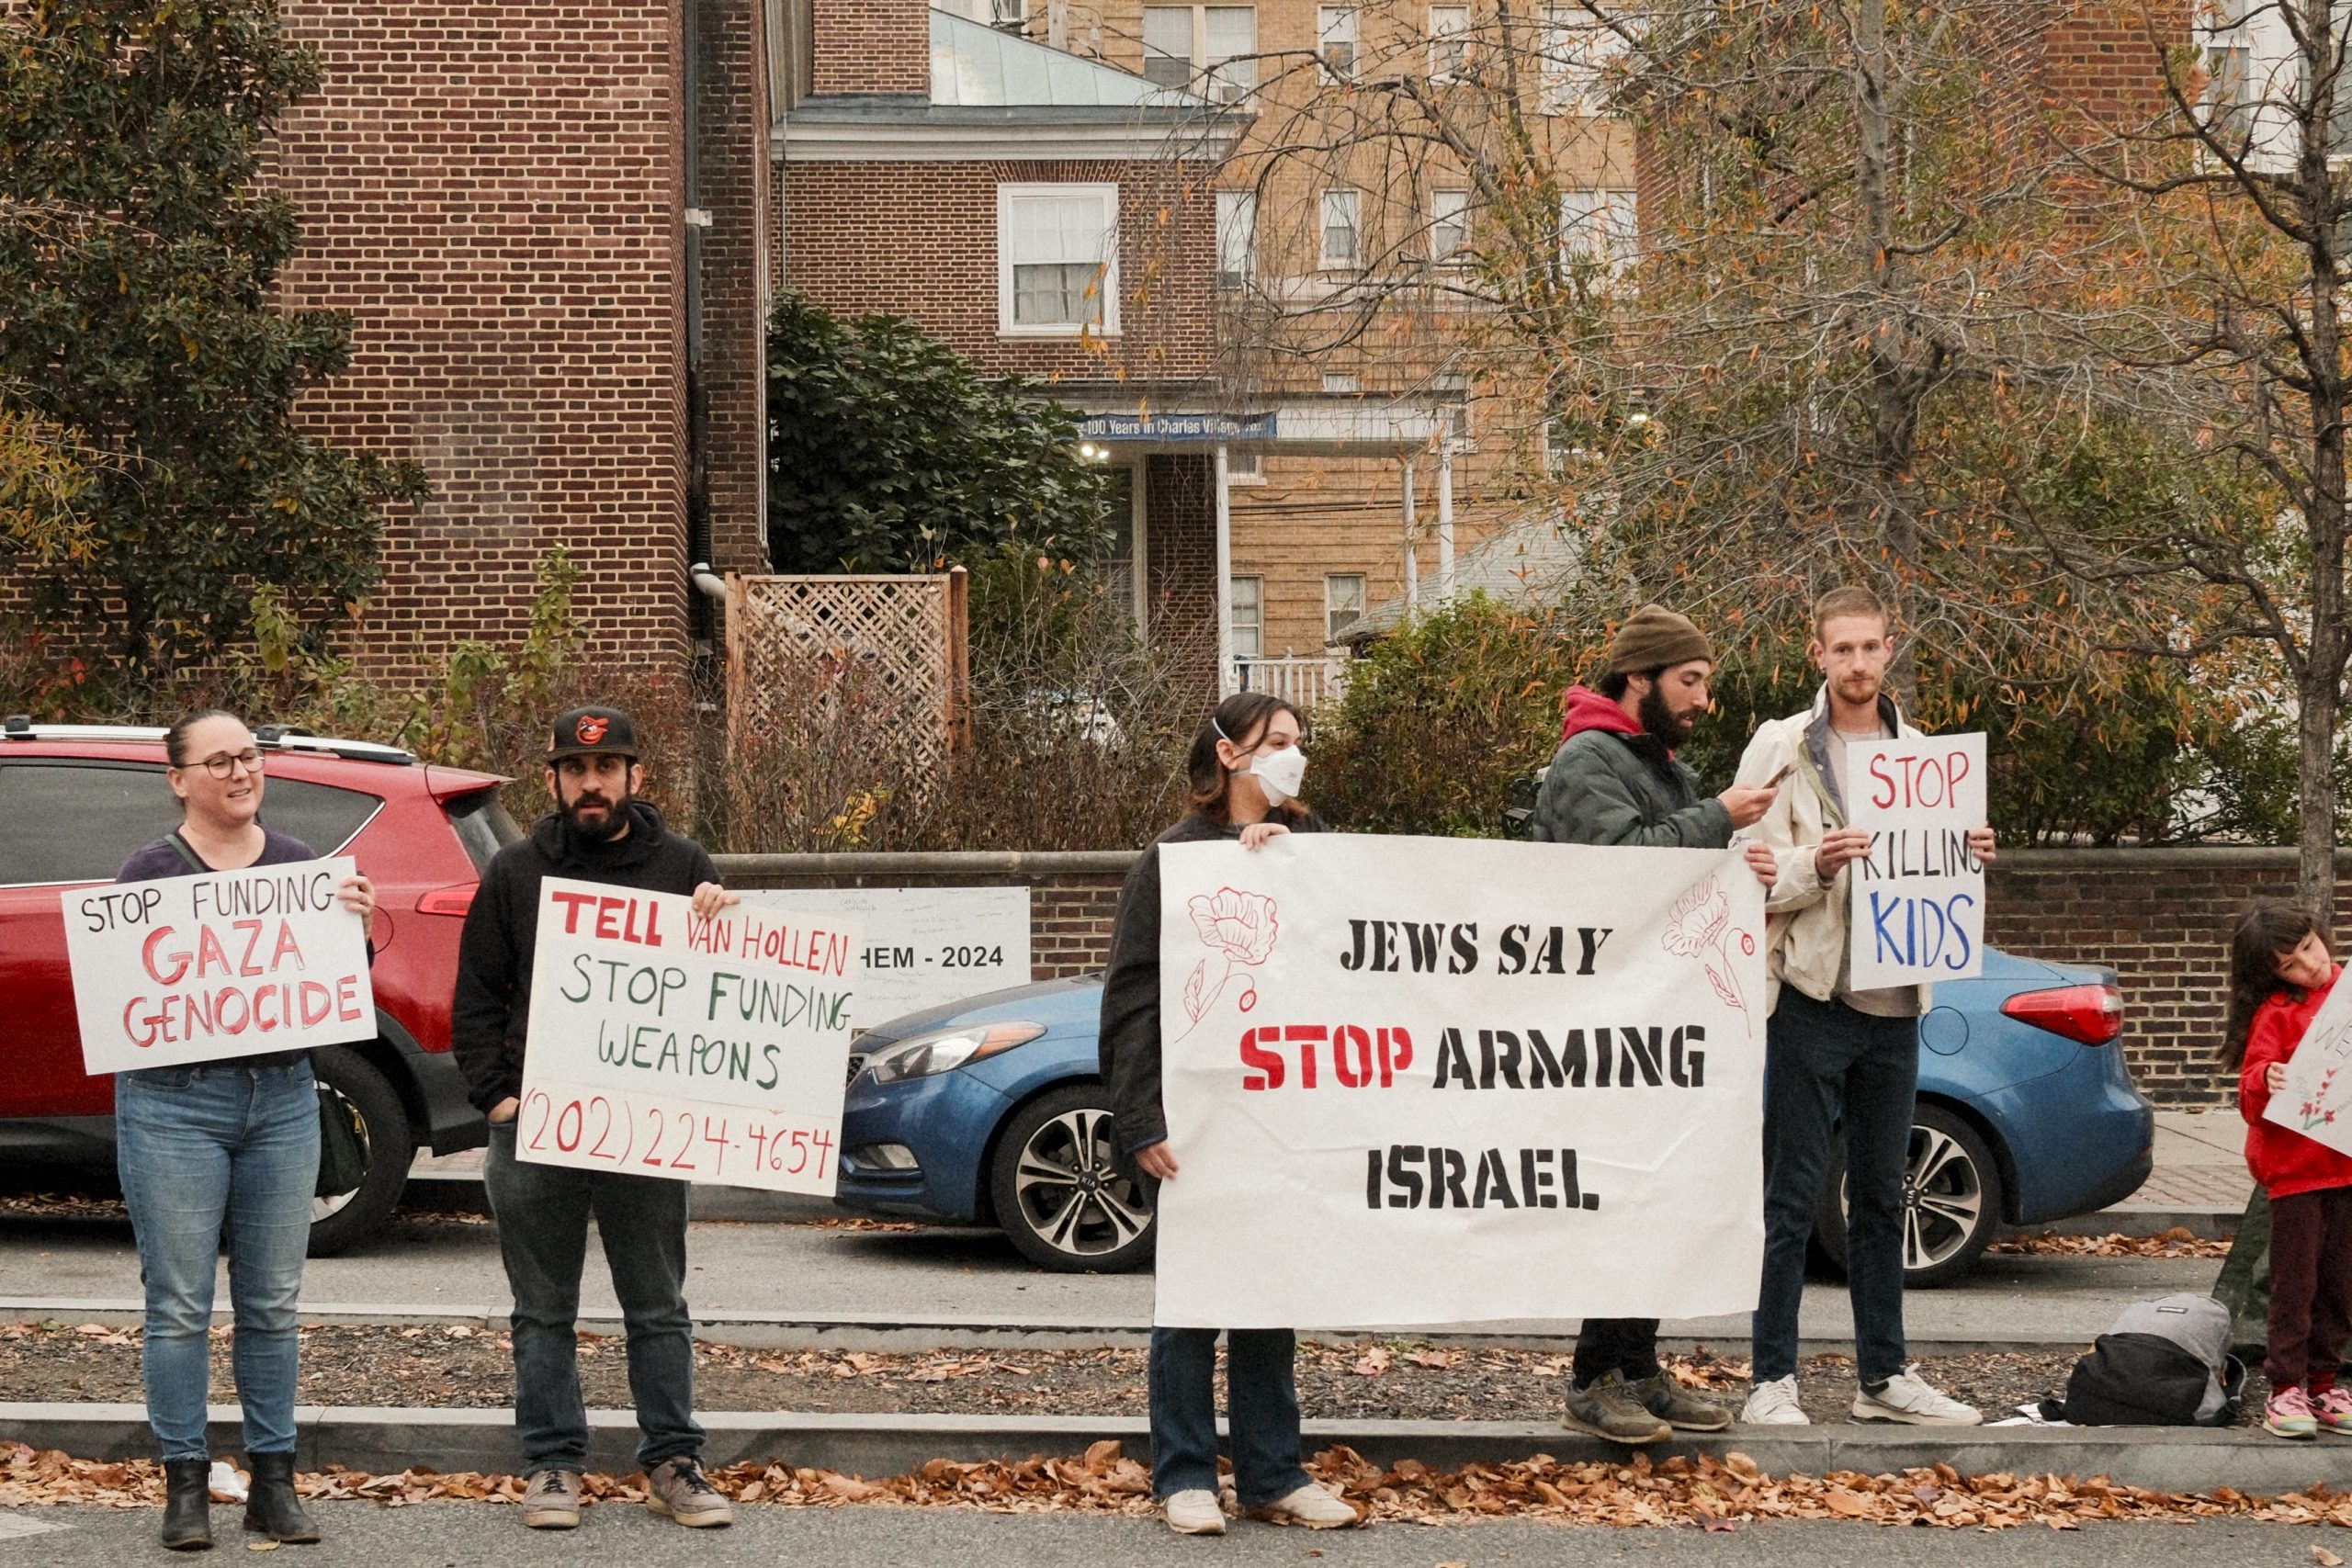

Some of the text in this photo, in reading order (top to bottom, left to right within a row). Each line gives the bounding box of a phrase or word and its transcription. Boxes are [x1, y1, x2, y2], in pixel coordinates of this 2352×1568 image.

[1088, 420, 1106, 434] 100
[1110, 420, 1139, 434] Years
[1158, 419, 1200, 434] Charles
[1870, 751, 1969, 809] STOP
[82, 873, 334, 932] STOP FUNDING
[552, 891, 848, 976] TELL VAN HOLLEN
[1870, 891, 1974, 971] KIDS
[142, 919, 305, 986] GAZA
[941, 946, 1003, 967] 2024
[1340, 919, 1613, 975] JEWS SAY
[123, 975, 362, 1047] GENOCIDE
[560, 954, 853, 1032] STOP FUNDING
[599, 1020, 780, 1090] WEAPONS
[1239, 1025, 1705, 1090] STOP ARMING
[1366, 1145, 1600, 1211] ISRAEL
